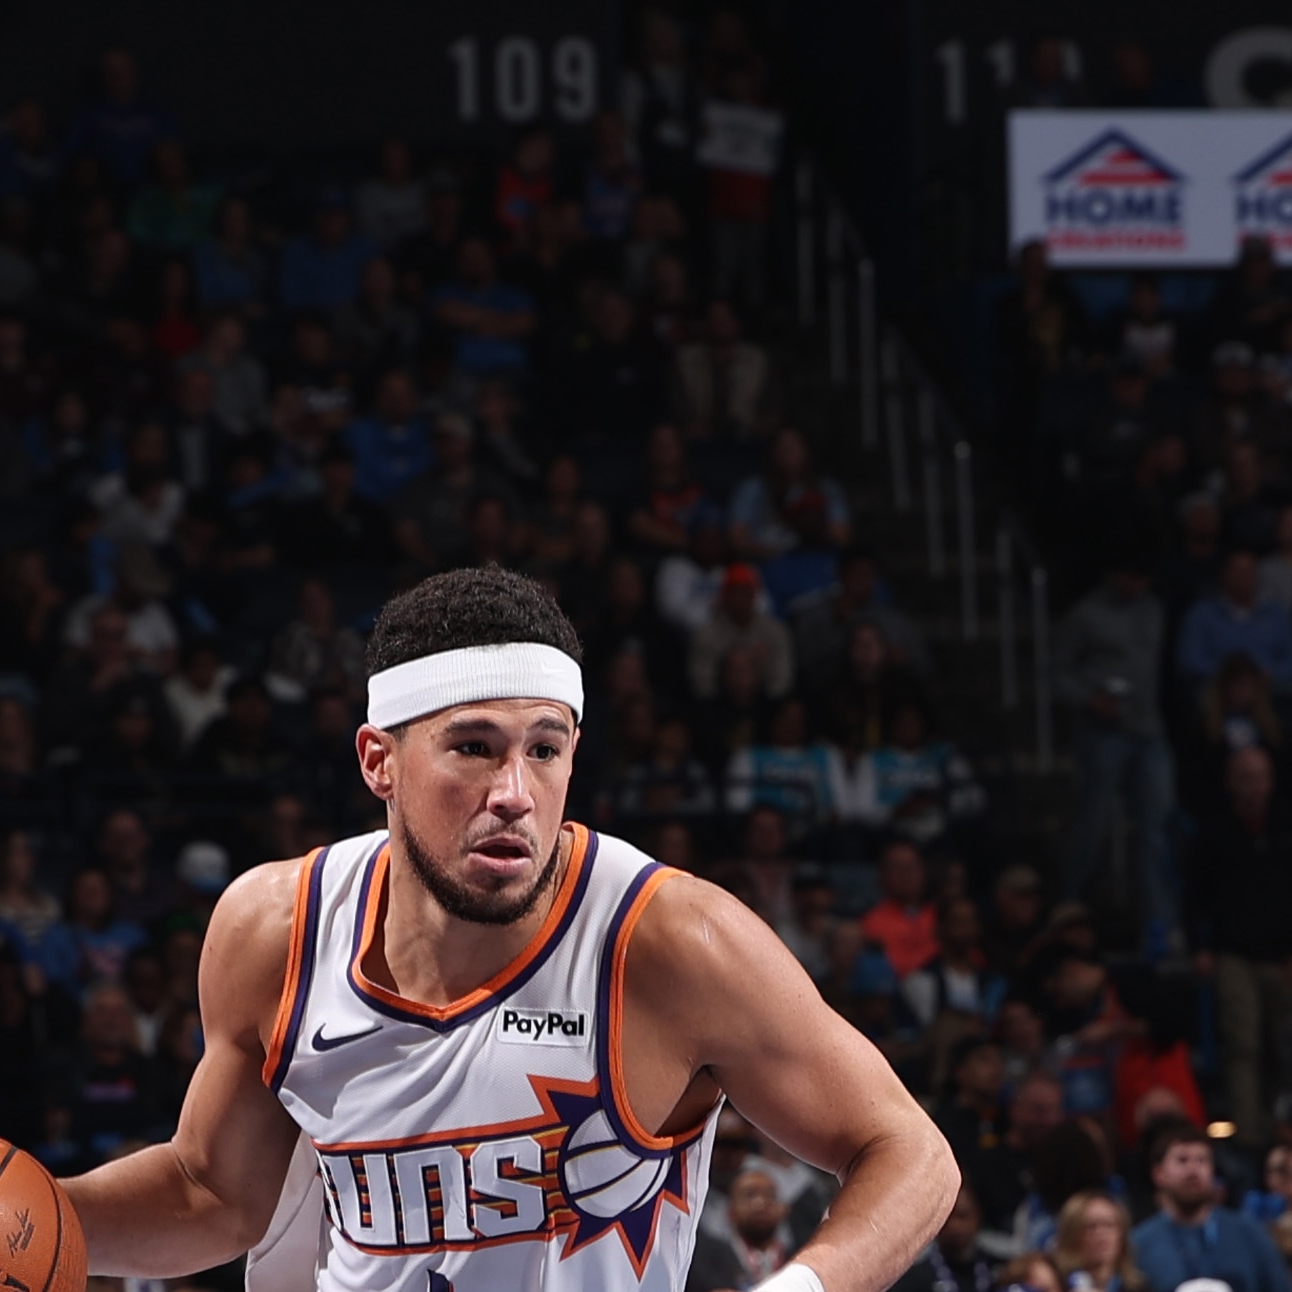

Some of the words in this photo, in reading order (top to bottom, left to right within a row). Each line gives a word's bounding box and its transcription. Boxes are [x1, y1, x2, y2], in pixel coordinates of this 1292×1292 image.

[446, 36, 600, 122] 109
[1045, 190, 1182, 224] HOME
[503, 1010, 584, 1042] PayPal
[315, 1134, 546, 1246] UNS
